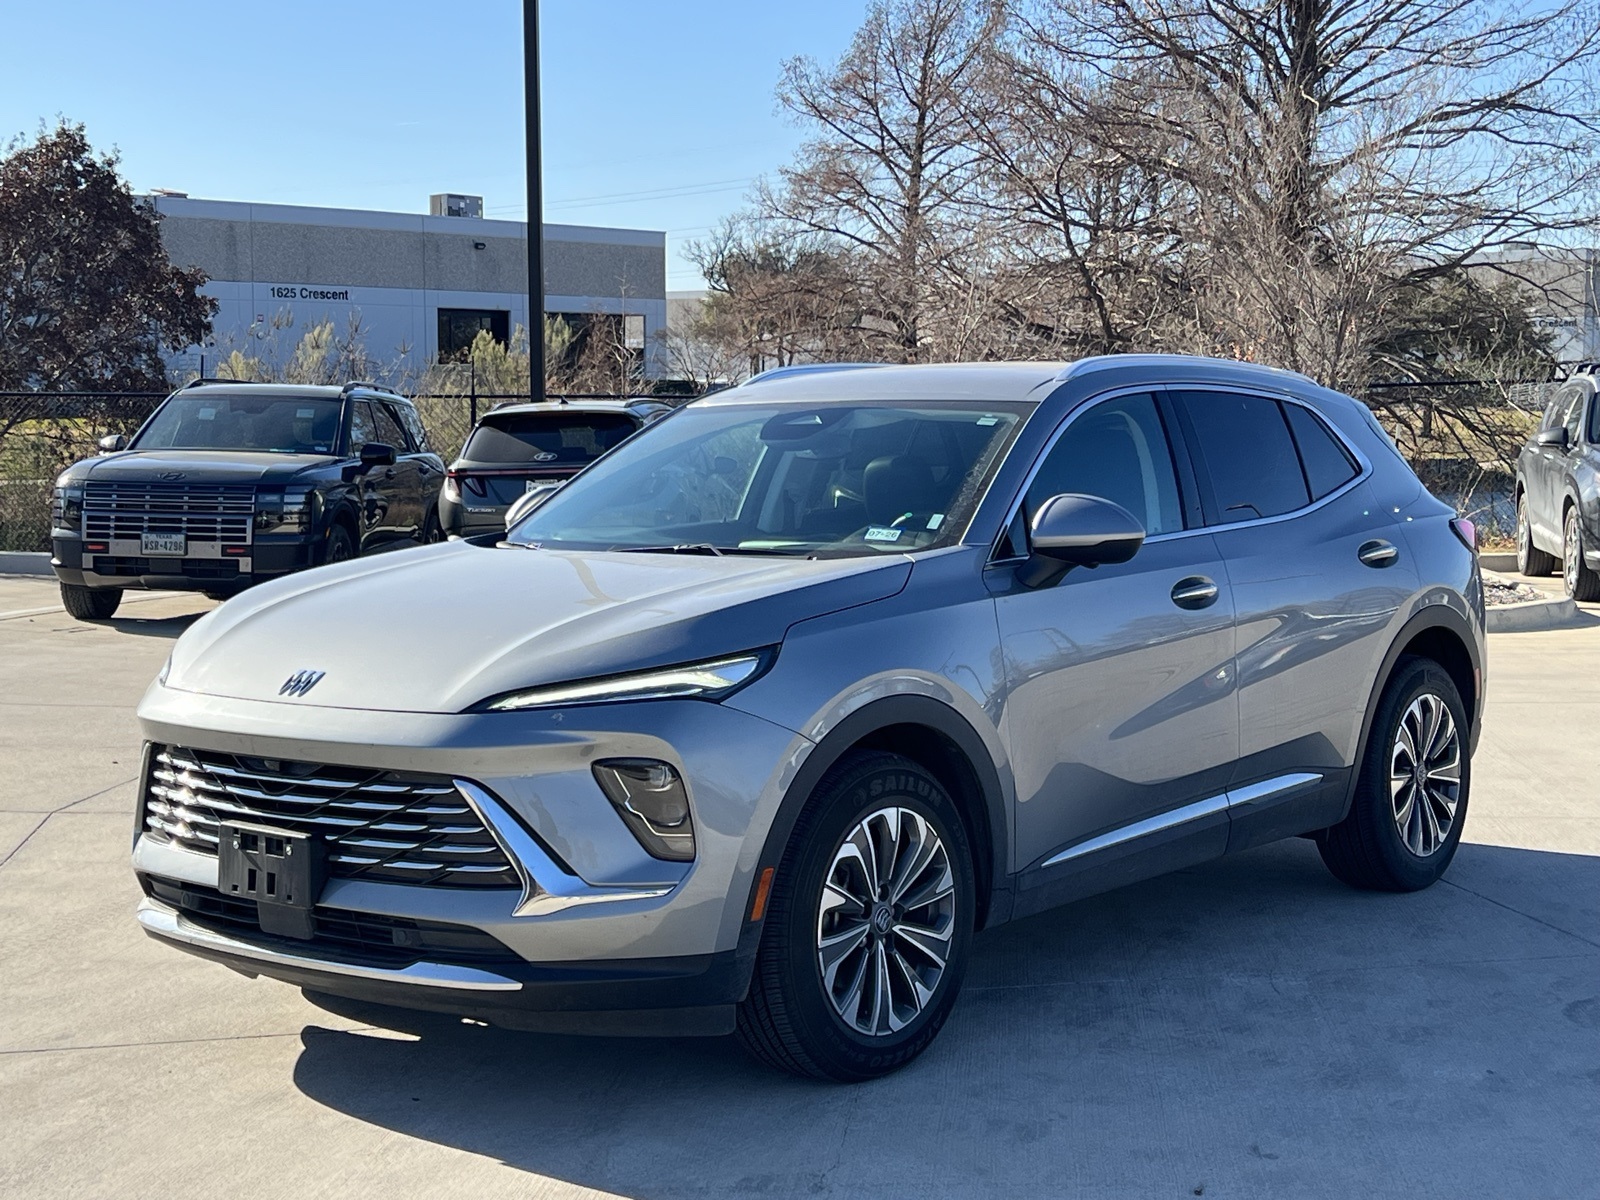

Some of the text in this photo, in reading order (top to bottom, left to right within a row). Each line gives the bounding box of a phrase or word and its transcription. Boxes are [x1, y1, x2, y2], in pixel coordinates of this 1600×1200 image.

[270, 287, 349, 301] 1625 Crescent
[868, 530, 898, 538] 07-26
[869, 775, 941, 807] SAILUN
